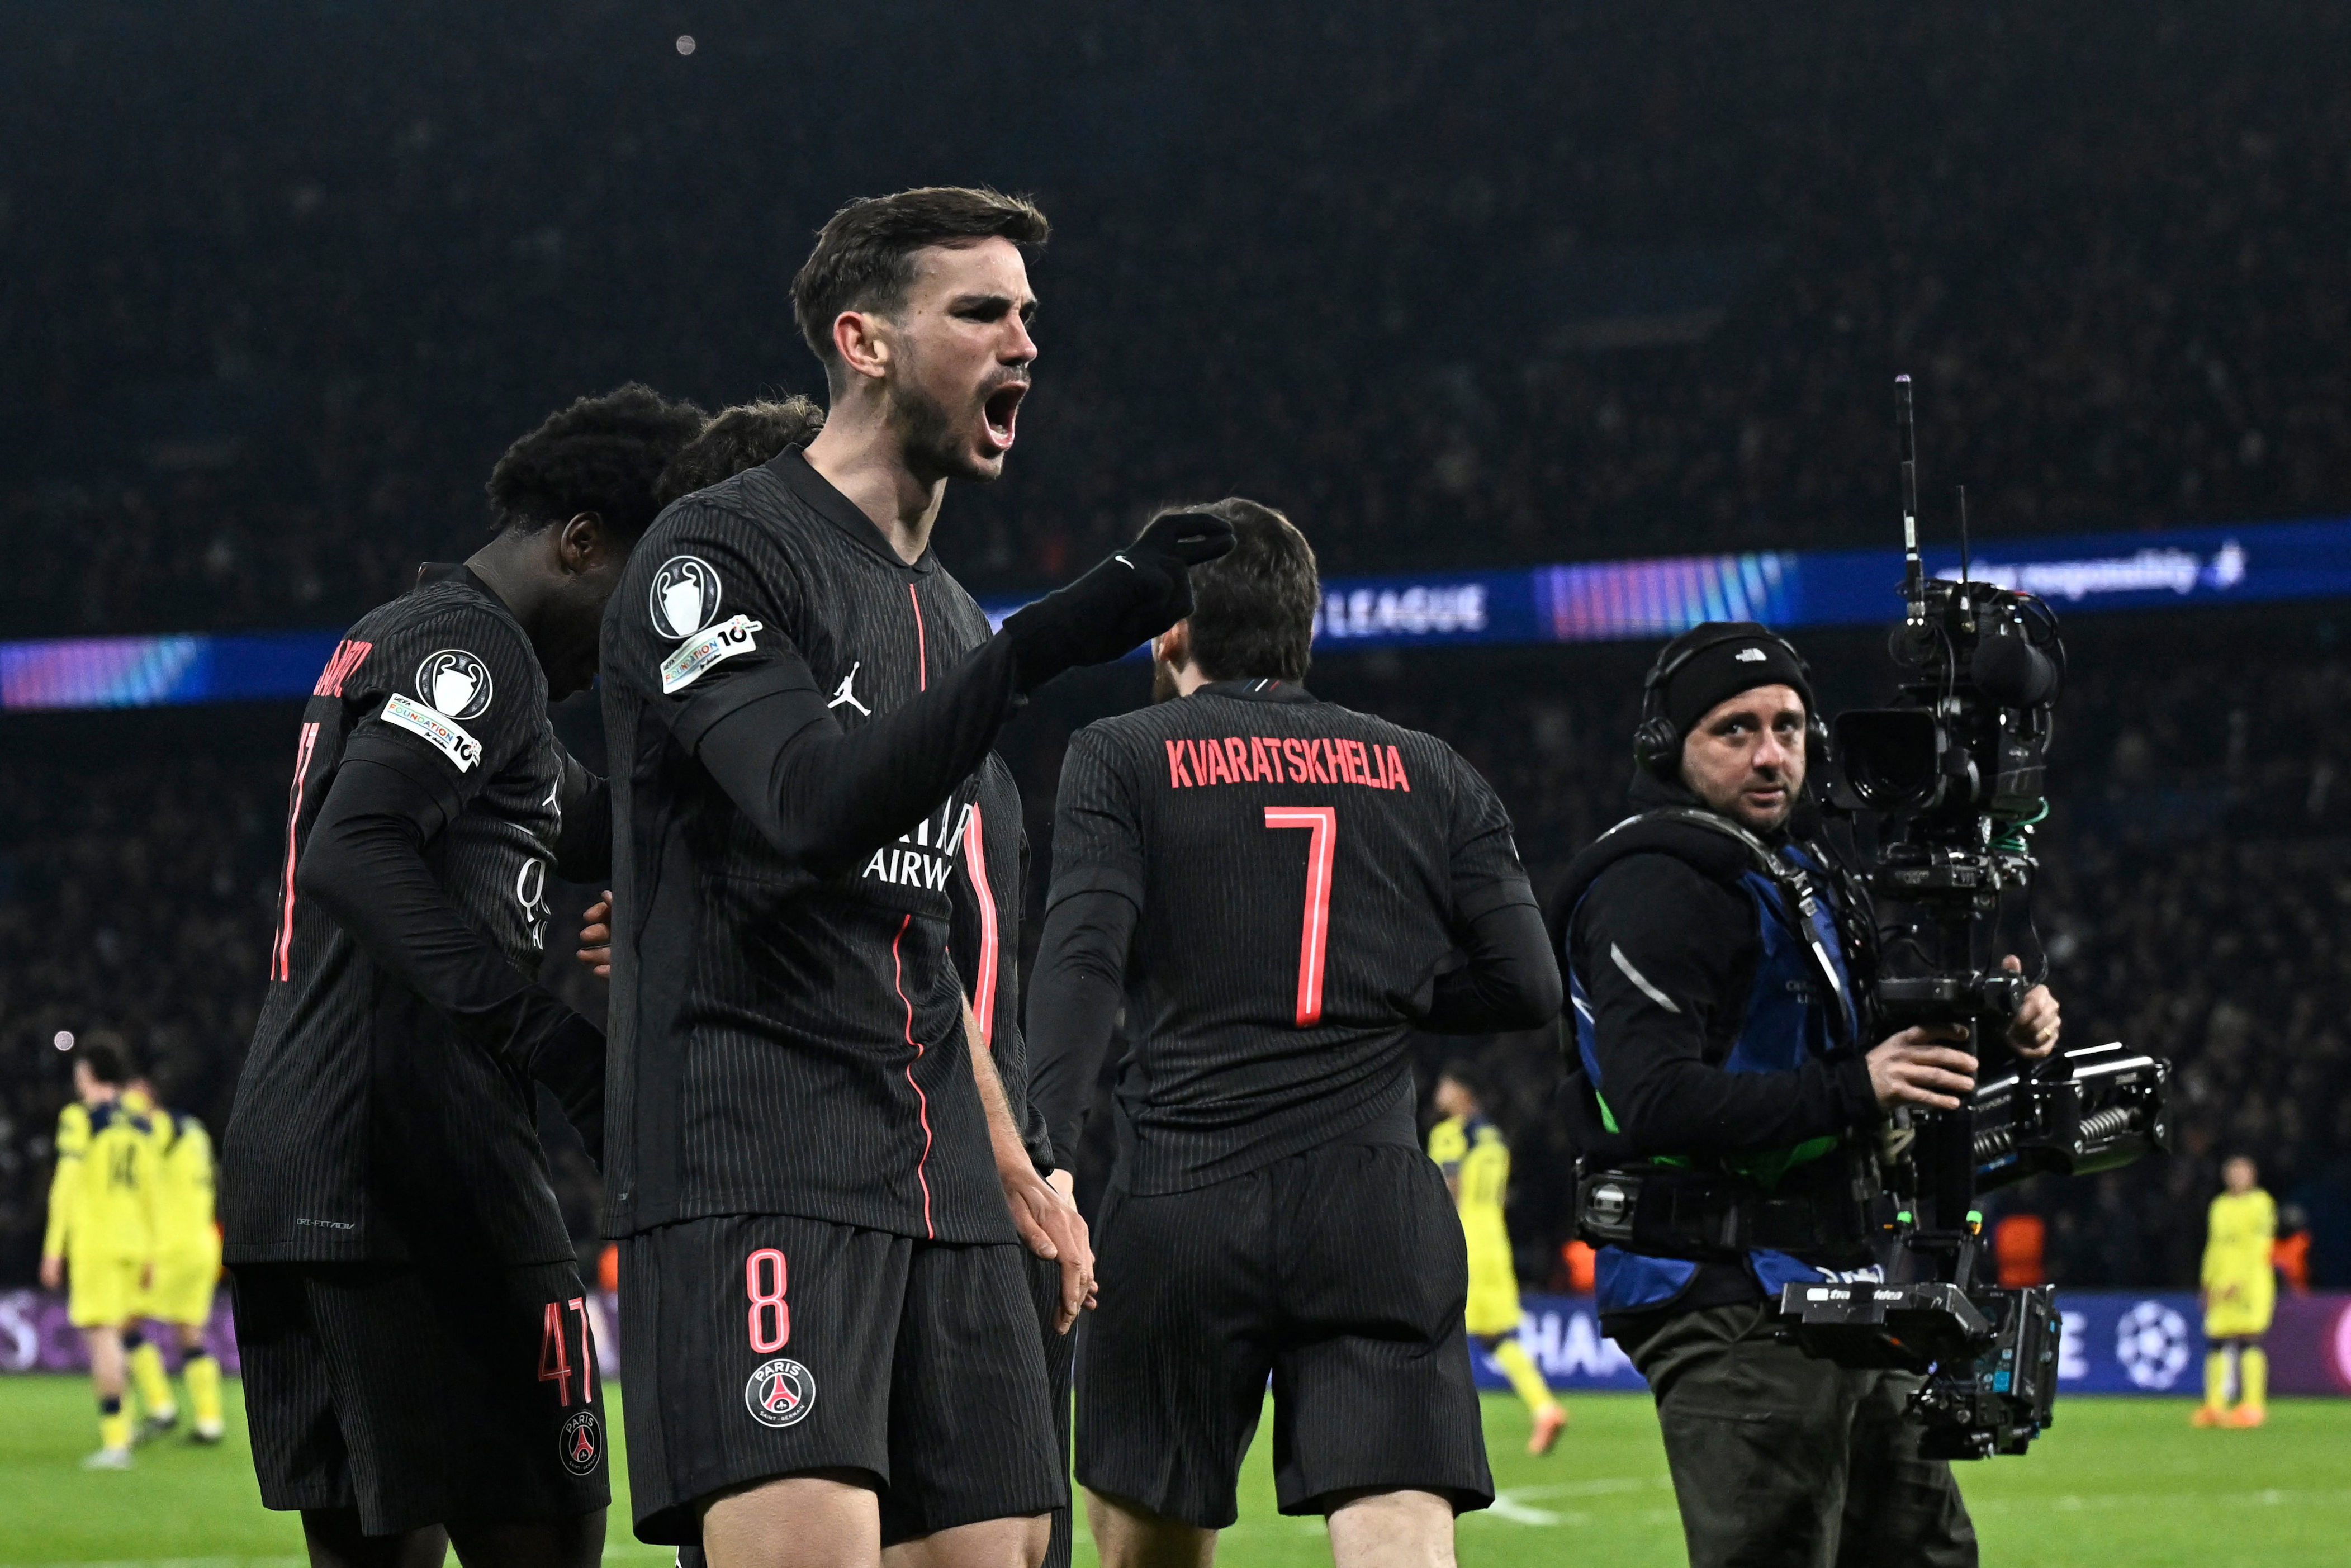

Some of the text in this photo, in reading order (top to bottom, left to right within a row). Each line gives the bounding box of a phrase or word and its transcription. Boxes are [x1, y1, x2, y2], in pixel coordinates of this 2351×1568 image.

[388, 703, 454, 742] FOUNDATION
[1166, 736, 1410, 792] KVARATSKHELIA
[1264, 806, 1336, 1028] 7
[746, 1248, 790, 1353] 8
[754, 1362, 801, 1382] PARIS
[565, 1414, 594, 1433] PARIS
